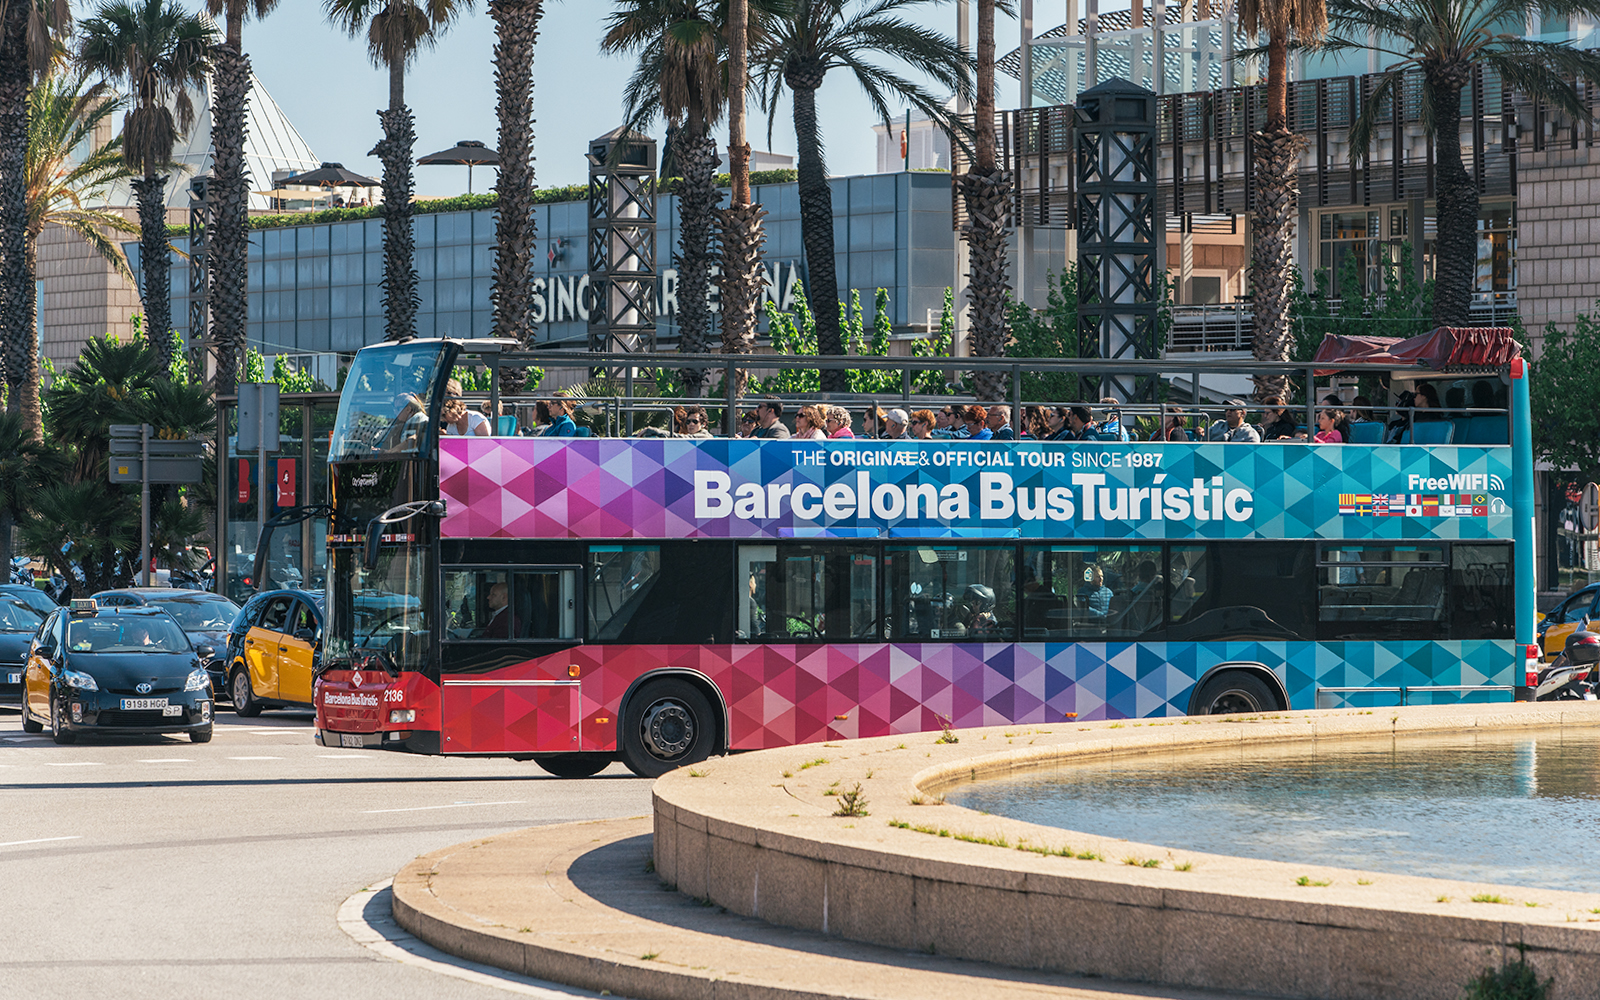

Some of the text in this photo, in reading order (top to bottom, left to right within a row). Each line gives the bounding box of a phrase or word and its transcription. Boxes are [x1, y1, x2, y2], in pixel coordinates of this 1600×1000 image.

[791, 450, 827, 466] THE
[918, 450, 931, 467] &
[932, 451, 1014, 467] OFFICIAL
[1017, 451, 1065, 467] TOUR
[1071, 451, 1122, 468] SINCE
[1124, 452, 1163, 468] 1987
[1408, 473, 1488, 491] FreeWIFI
[693, 469, 1254, 523] Barcelona BusTurístic
[126, 699, 167, 709] 9198 HGG
[324, 691, 351, 705] Barcelona
[383, 689, 403, 703] 2136
